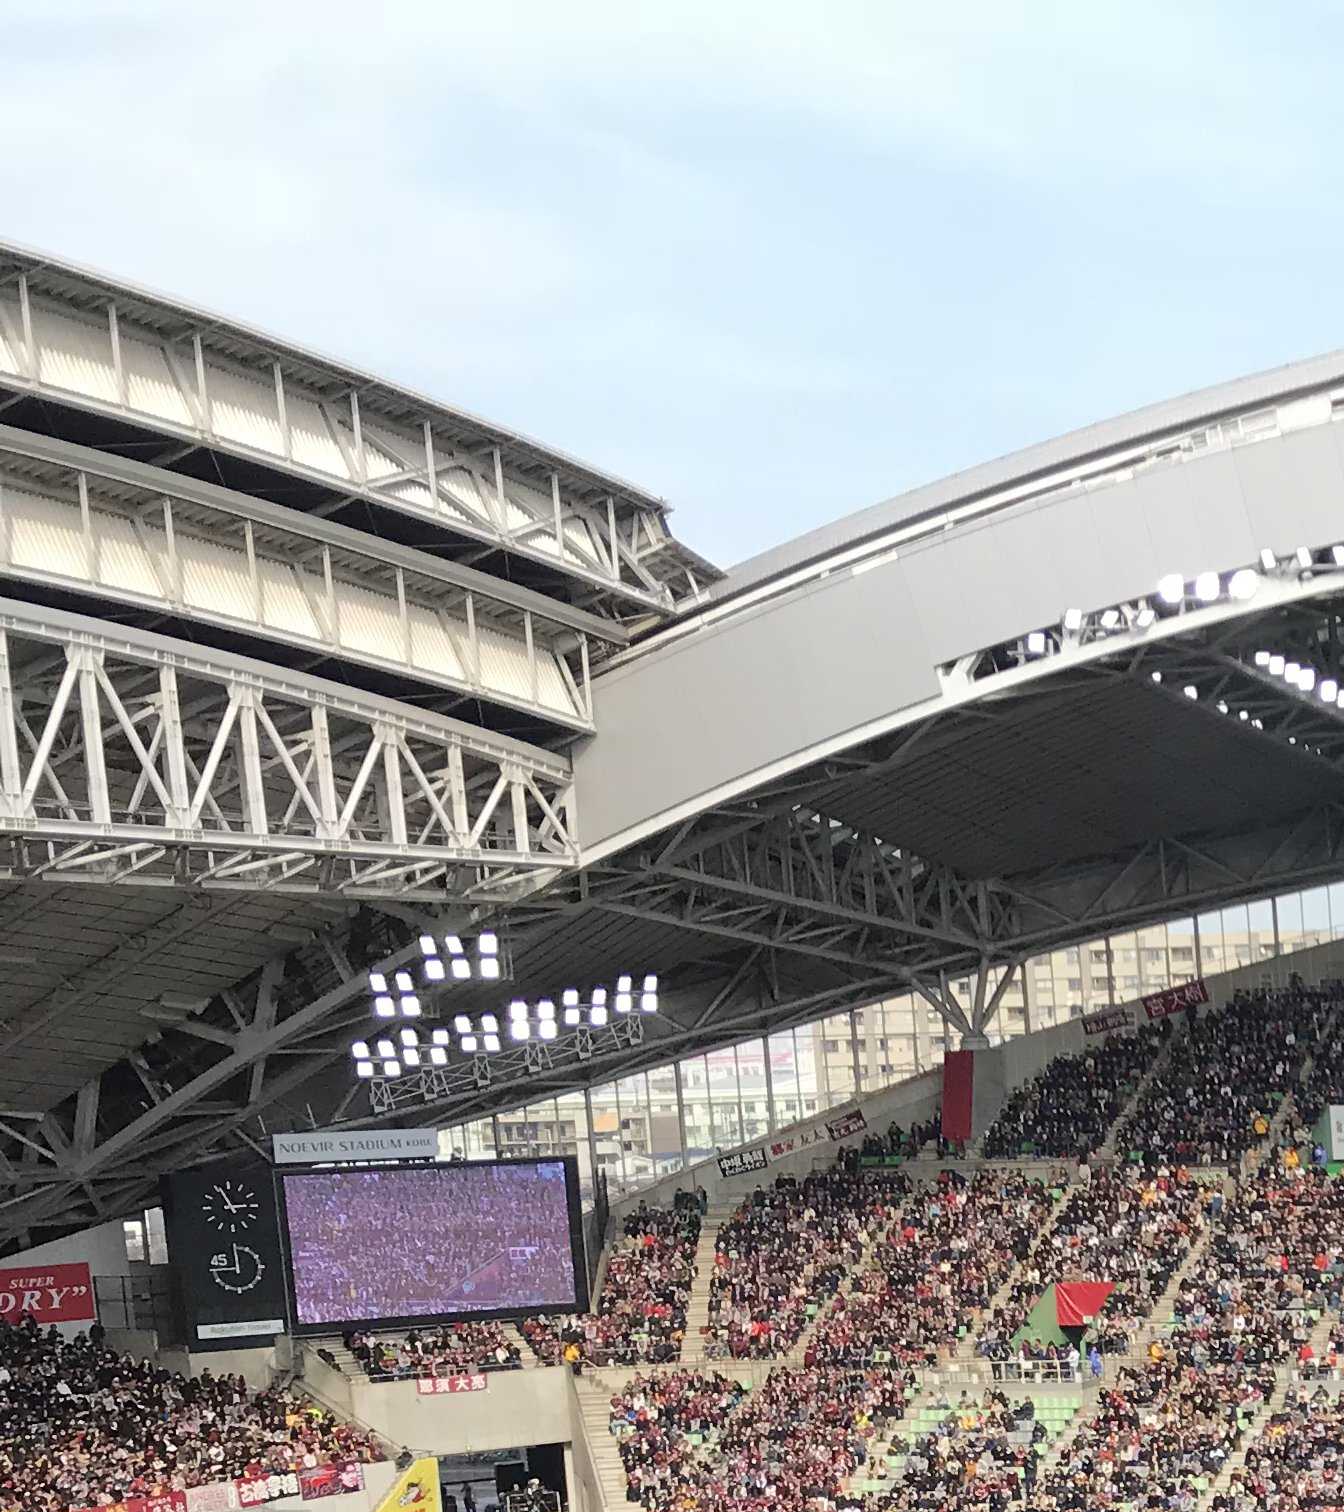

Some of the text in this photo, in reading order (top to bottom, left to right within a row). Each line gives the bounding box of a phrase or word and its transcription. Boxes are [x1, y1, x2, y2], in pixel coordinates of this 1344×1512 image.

[338, 1138, 402, 1151] STADIUM
[210, 1254, 227, 1266] 45
[9, 1276, 54, 1290] SUPER
